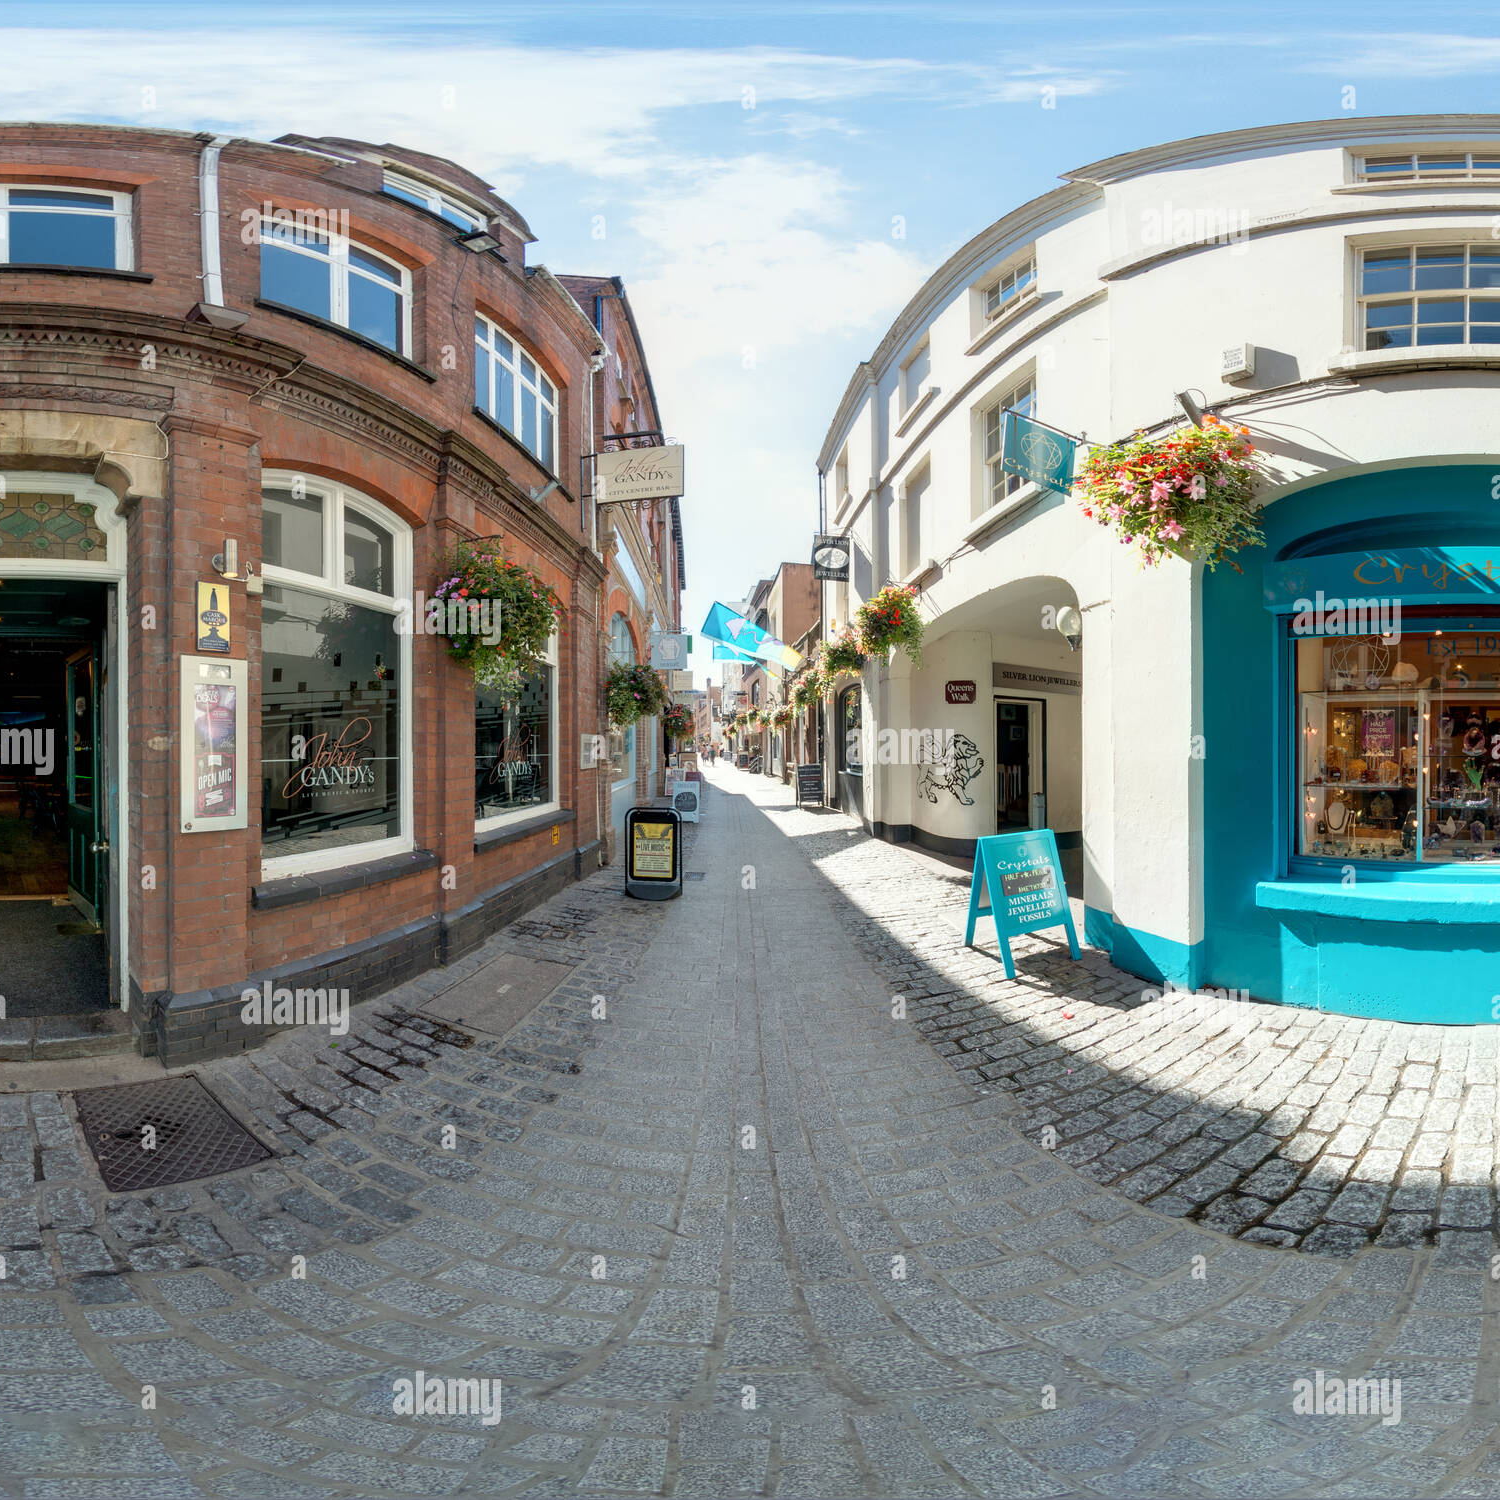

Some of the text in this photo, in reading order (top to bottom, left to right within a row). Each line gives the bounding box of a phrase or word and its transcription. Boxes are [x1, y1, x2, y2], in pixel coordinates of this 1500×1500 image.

[1004, 458, 1070, 489] Crystals
[947, 683, 974, 693] Queens
[1002, 671, 1081, 688] SILVER LION JEWELLERS
[951, 693, 971, 702] Walk
[283, 717, 372, 798] John
[198, 768, 232, 790] OPEN MIC
[301, 765, 375, 787] GANDY's
[997, 856, 1050, 870] Crystals
[1004, 872, 1020, 881] HALF
[1008, 890, 1054, 907] MINERALS
[1008, 900, 1057, 917] JEWELLERY
[1018, 910, 1052, 924] FOSSILS
